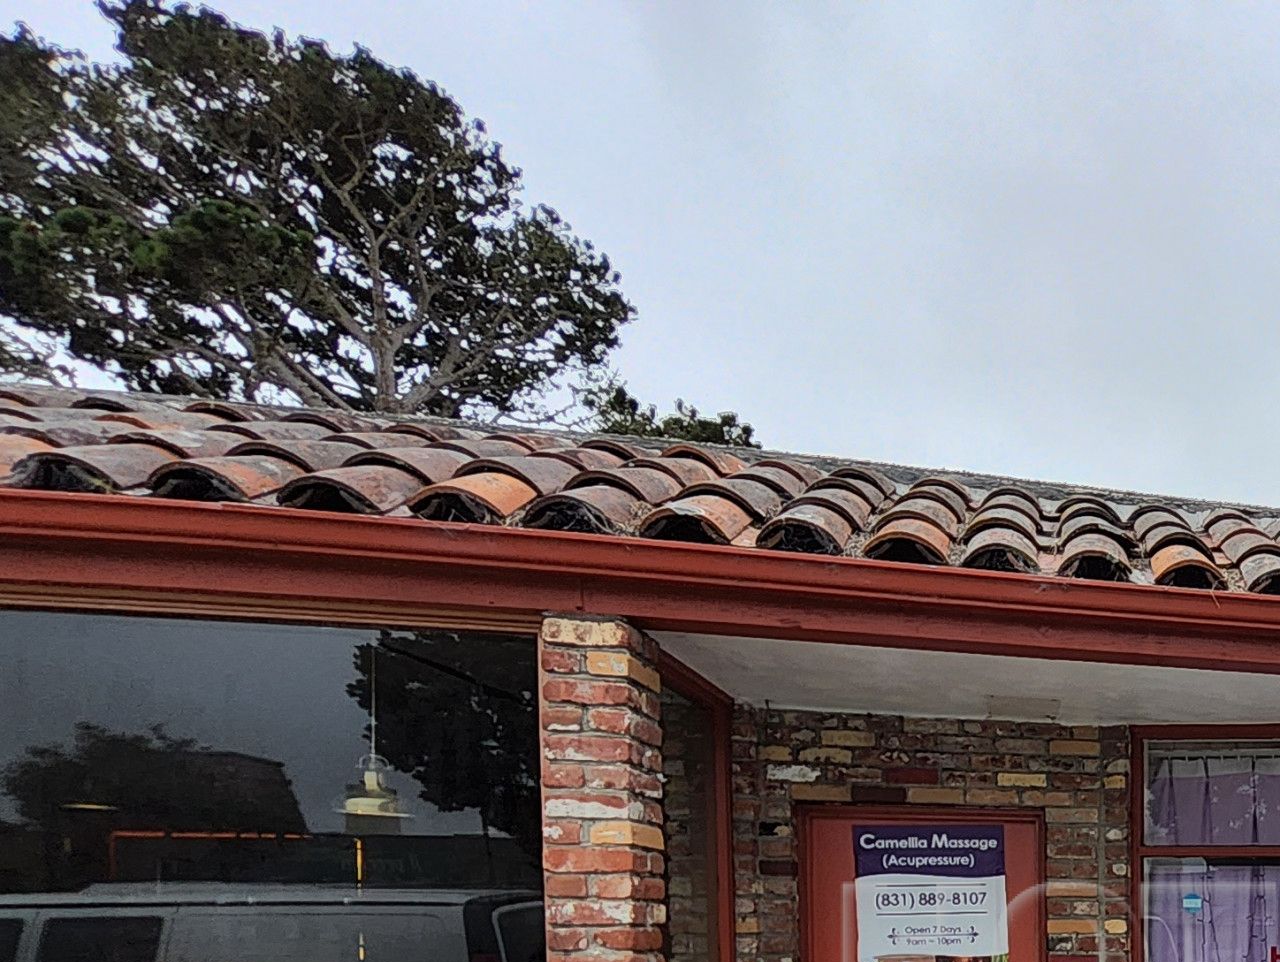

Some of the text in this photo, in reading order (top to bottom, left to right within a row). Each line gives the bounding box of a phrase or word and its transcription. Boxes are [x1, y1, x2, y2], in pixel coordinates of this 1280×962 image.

[859, 833, 998, 851] Camellia Massage
[882, 854, 975, 869] (Acupressure)
[875, 892, 987, 910] (831) 889-8107
[904, 925, 962, 936] Open 7 Days
[937, 937, 962, 946] 10pm
